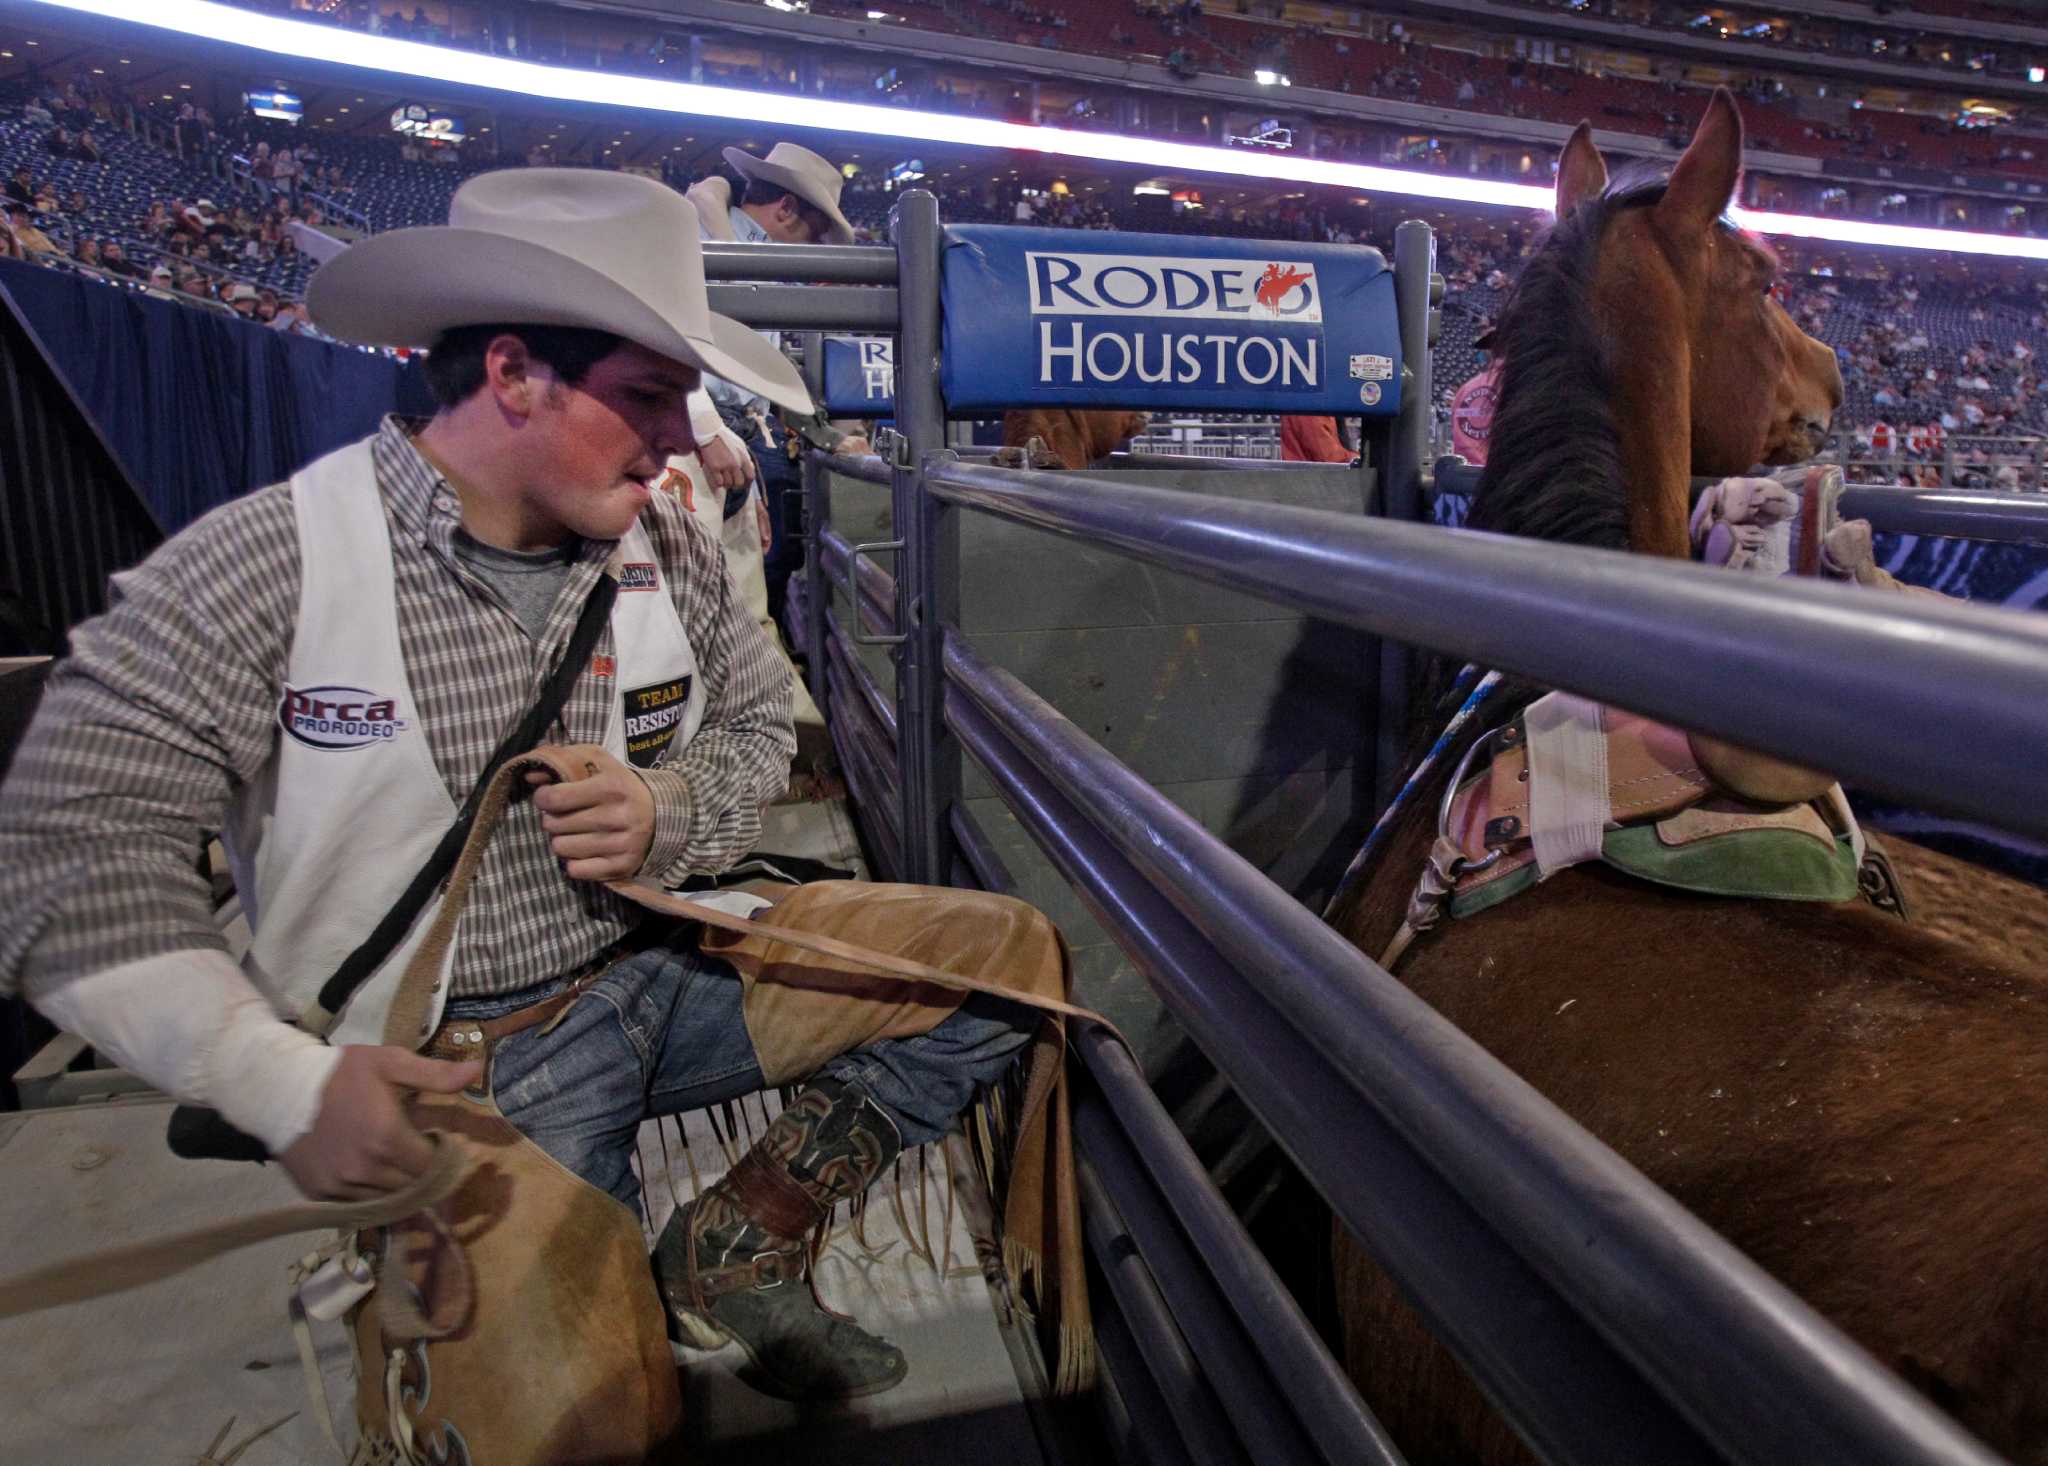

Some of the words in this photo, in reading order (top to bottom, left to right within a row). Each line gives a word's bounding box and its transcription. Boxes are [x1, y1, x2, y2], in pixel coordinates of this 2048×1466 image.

[1034, 255, 1313, 315] RODEO
[1039, 321, 1318, 386] HOUSTON
[285, 687, 395, 727] prca
[638, 683, 684, 709] TEAM
[295, 716, 393, 737] PRORODEO
